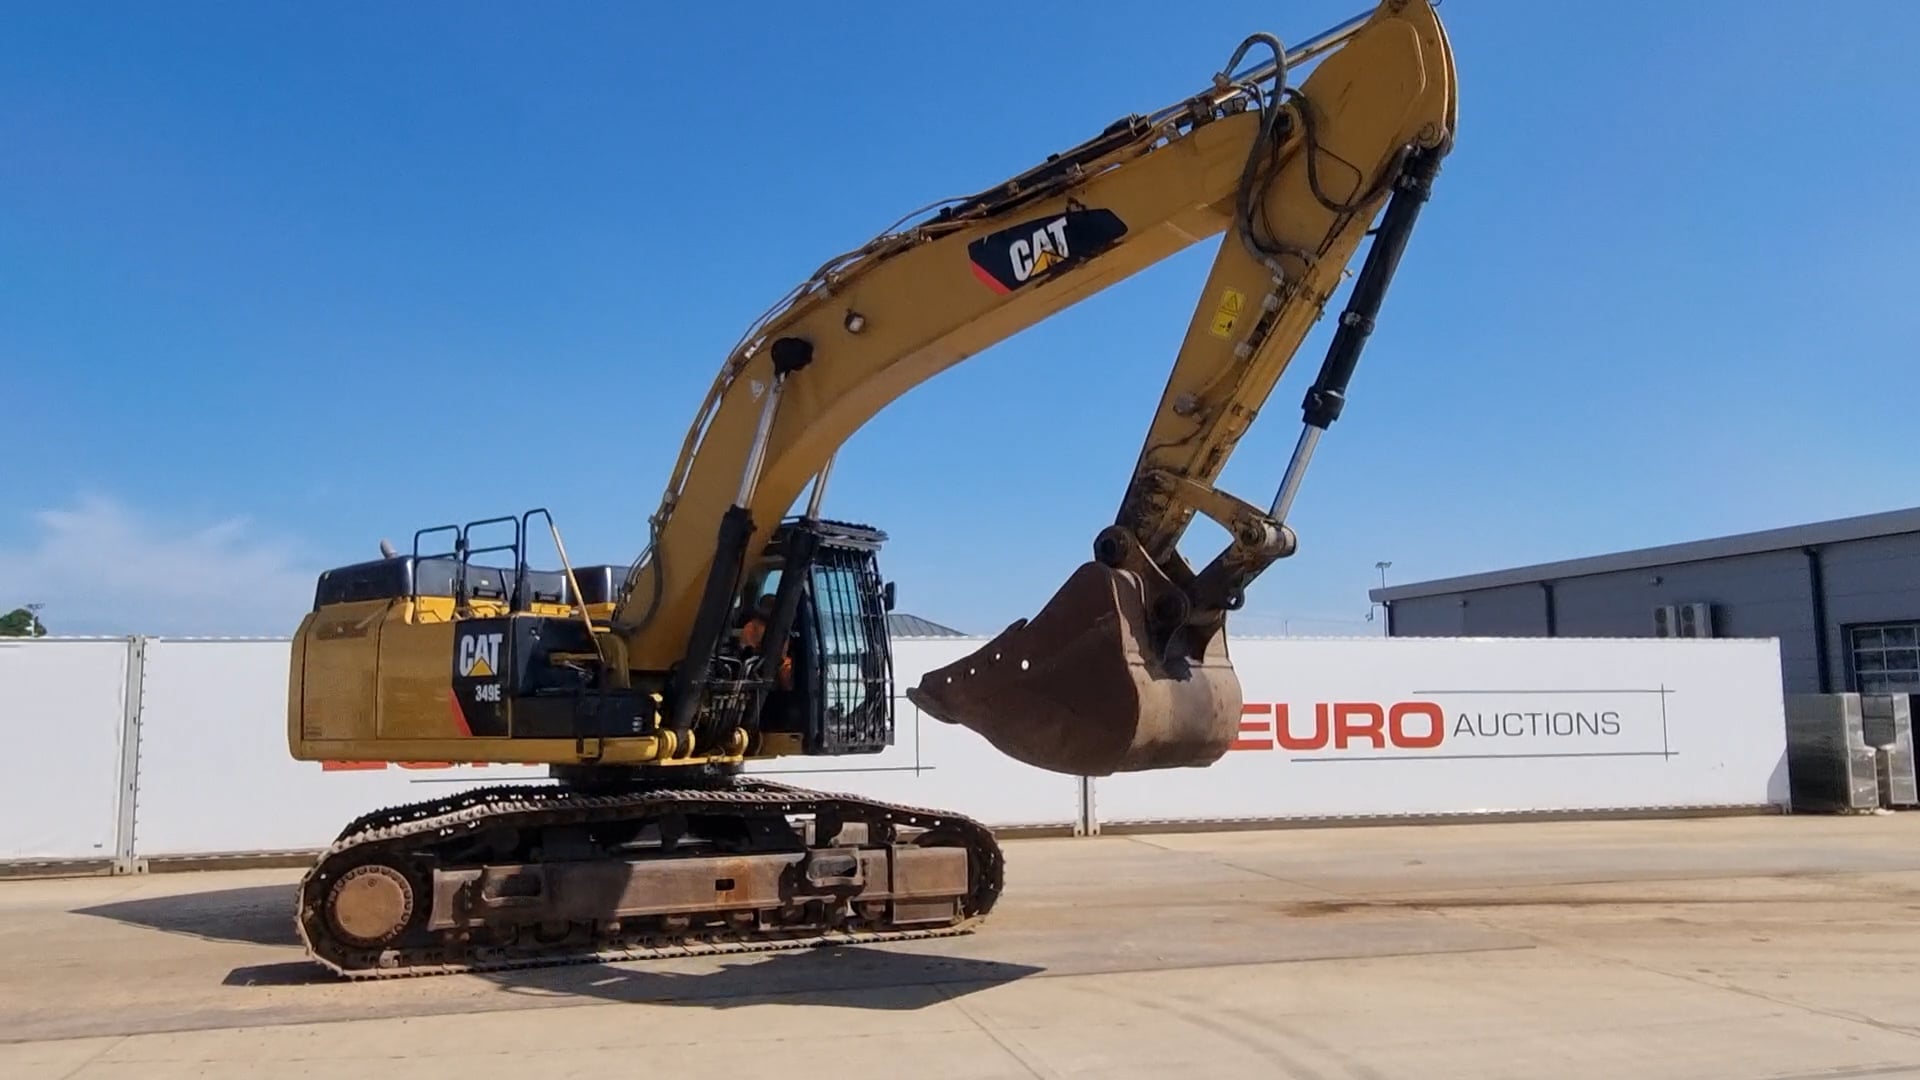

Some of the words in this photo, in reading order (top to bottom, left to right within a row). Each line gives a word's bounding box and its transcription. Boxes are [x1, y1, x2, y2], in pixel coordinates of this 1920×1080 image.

[1009, 216, 1069, 281] CAT
[459, 633, 503, 677] CAT
[475, 684, 501, 702] 349E
[1230, 702, 1445, 751] EURO
[1453, 712, 1621, 737] AUCTIONS
